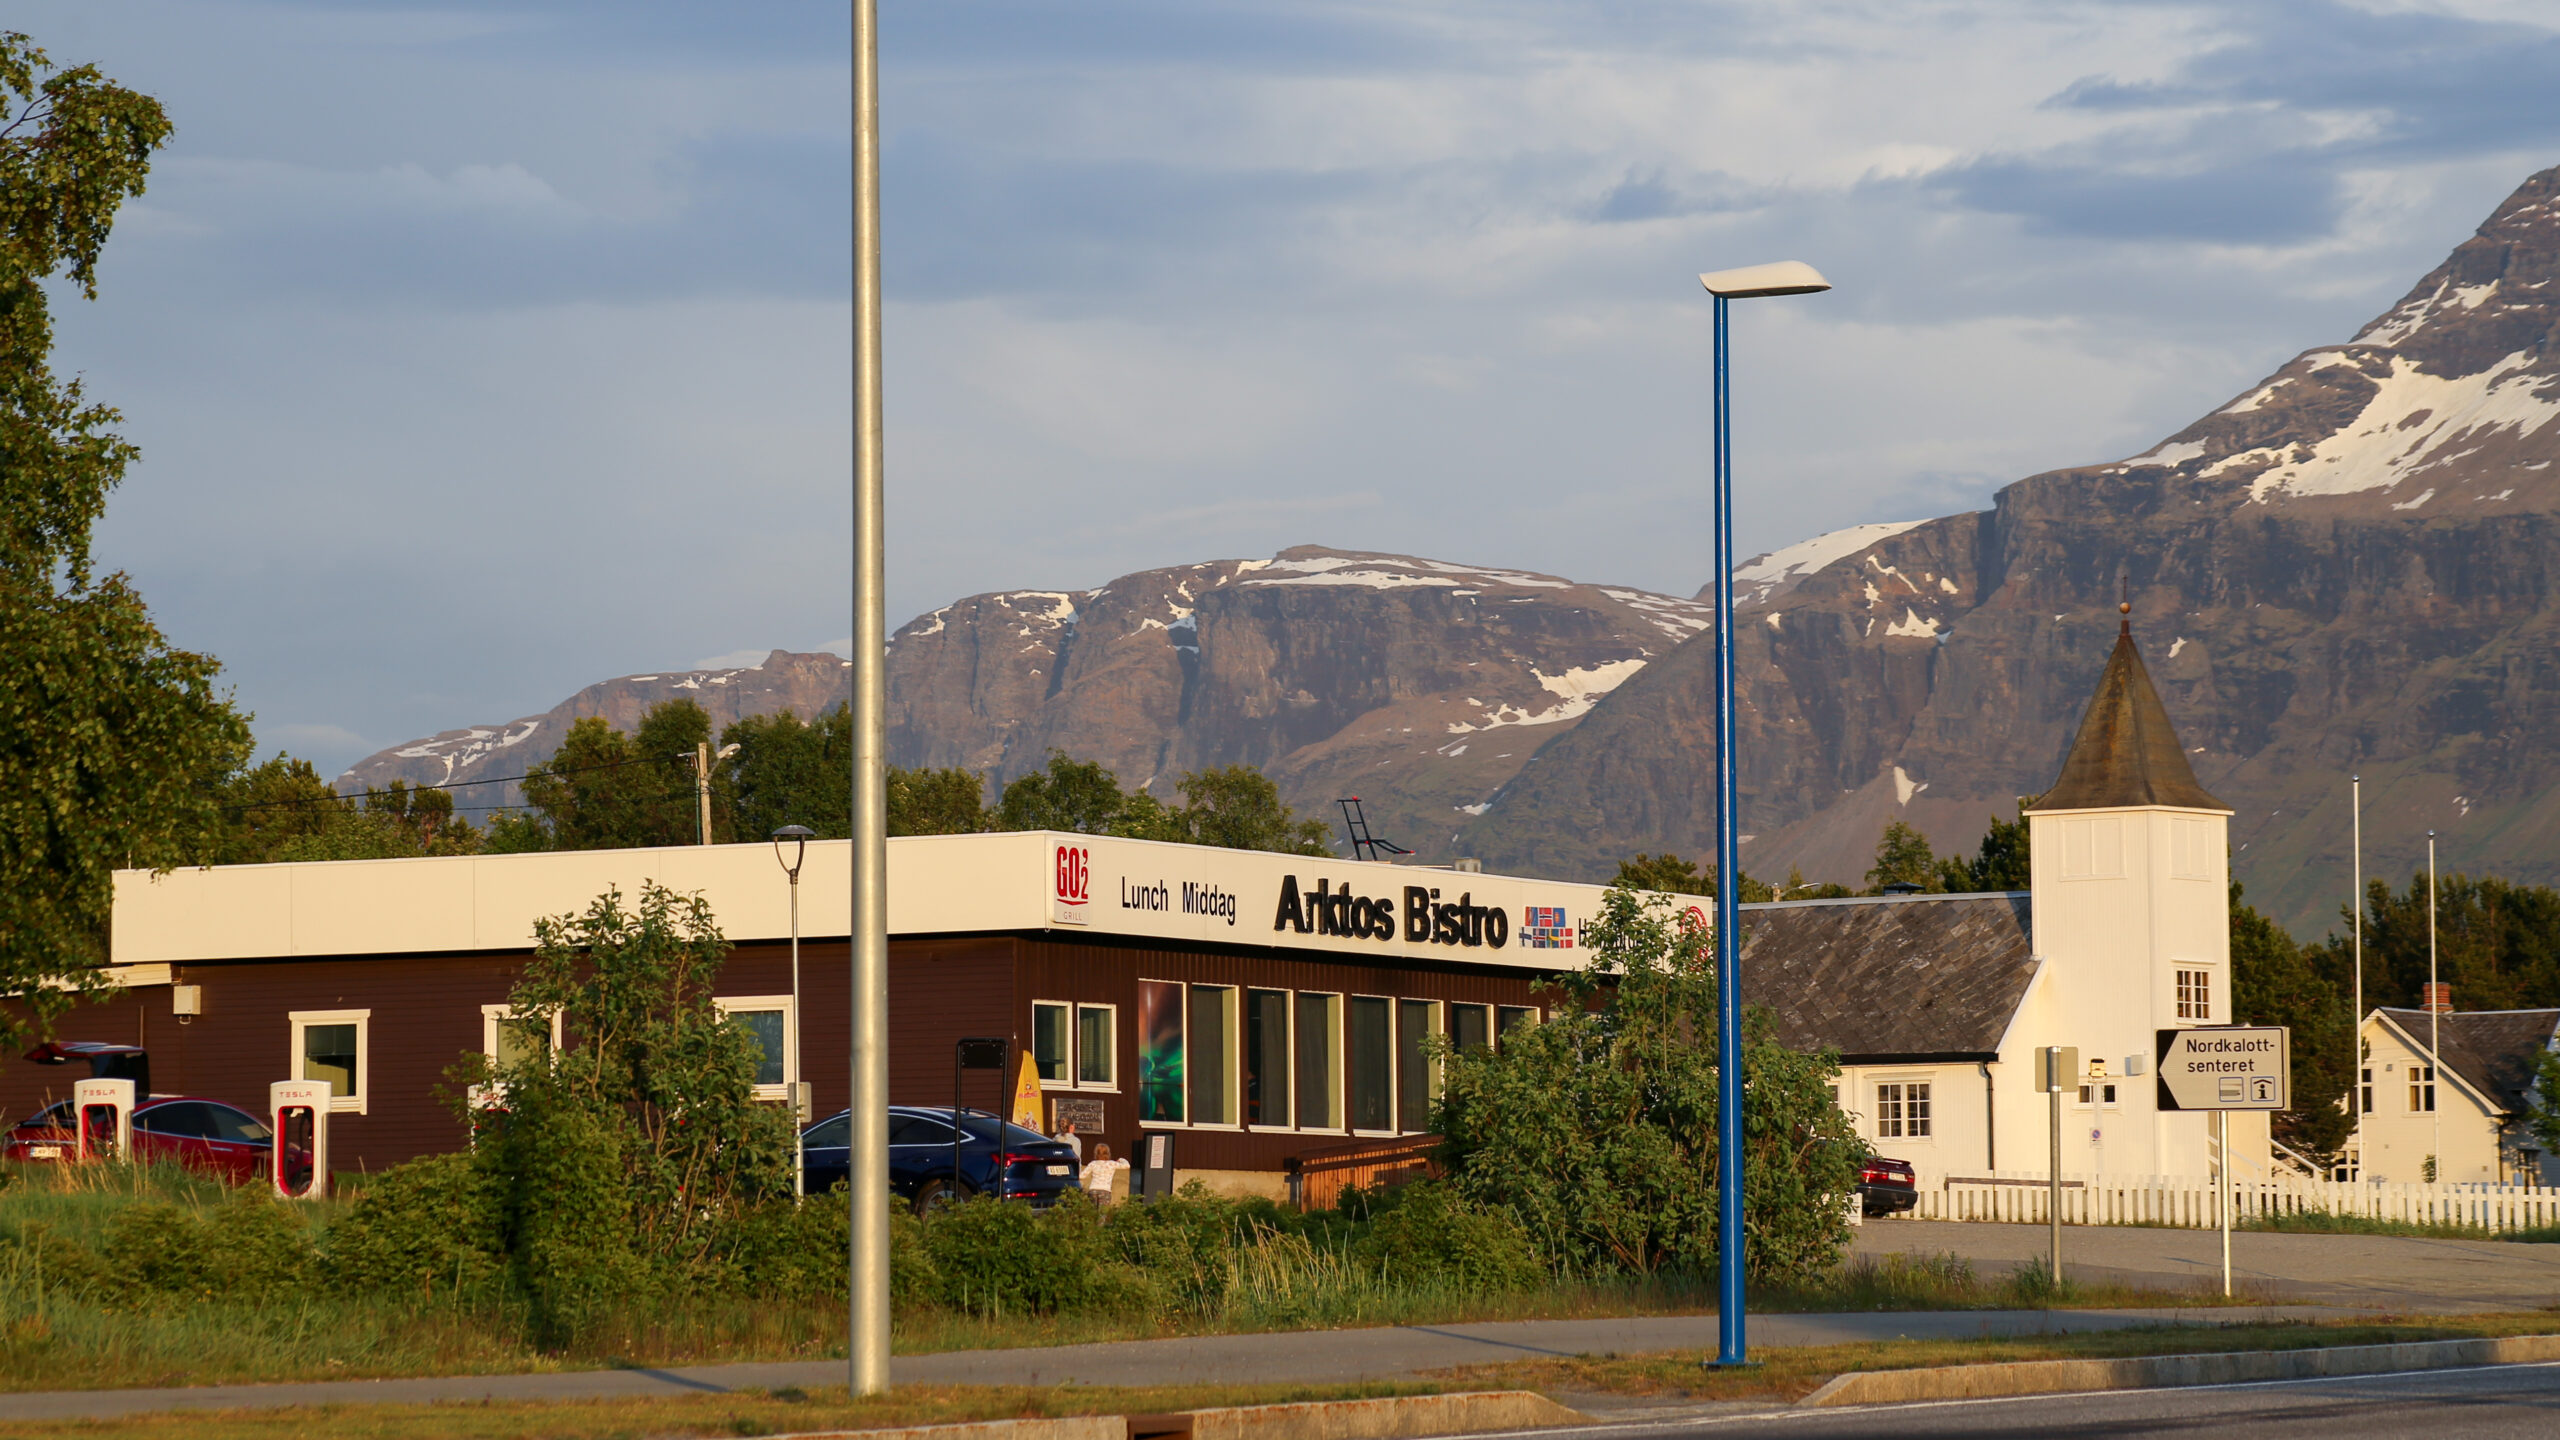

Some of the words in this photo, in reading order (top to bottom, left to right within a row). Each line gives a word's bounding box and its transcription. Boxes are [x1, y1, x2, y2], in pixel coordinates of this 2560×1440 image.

[1121, 876, 1169, 912] Lunch
[1182, 881, 1236, 926] Middag
[1063, 911, 1083, 922] GRILL
[1273, 874, 1395, 942] Arktos
[1403, 885, 1509, 950] Bistro
[2186, 1038, 2275, 1053] Nordkalott-
[2187, 1059, 2255, 1073] senteret
[82, 1088, 116, 1097] TESLA
[279, 1090, 313, 1098] TESLA
